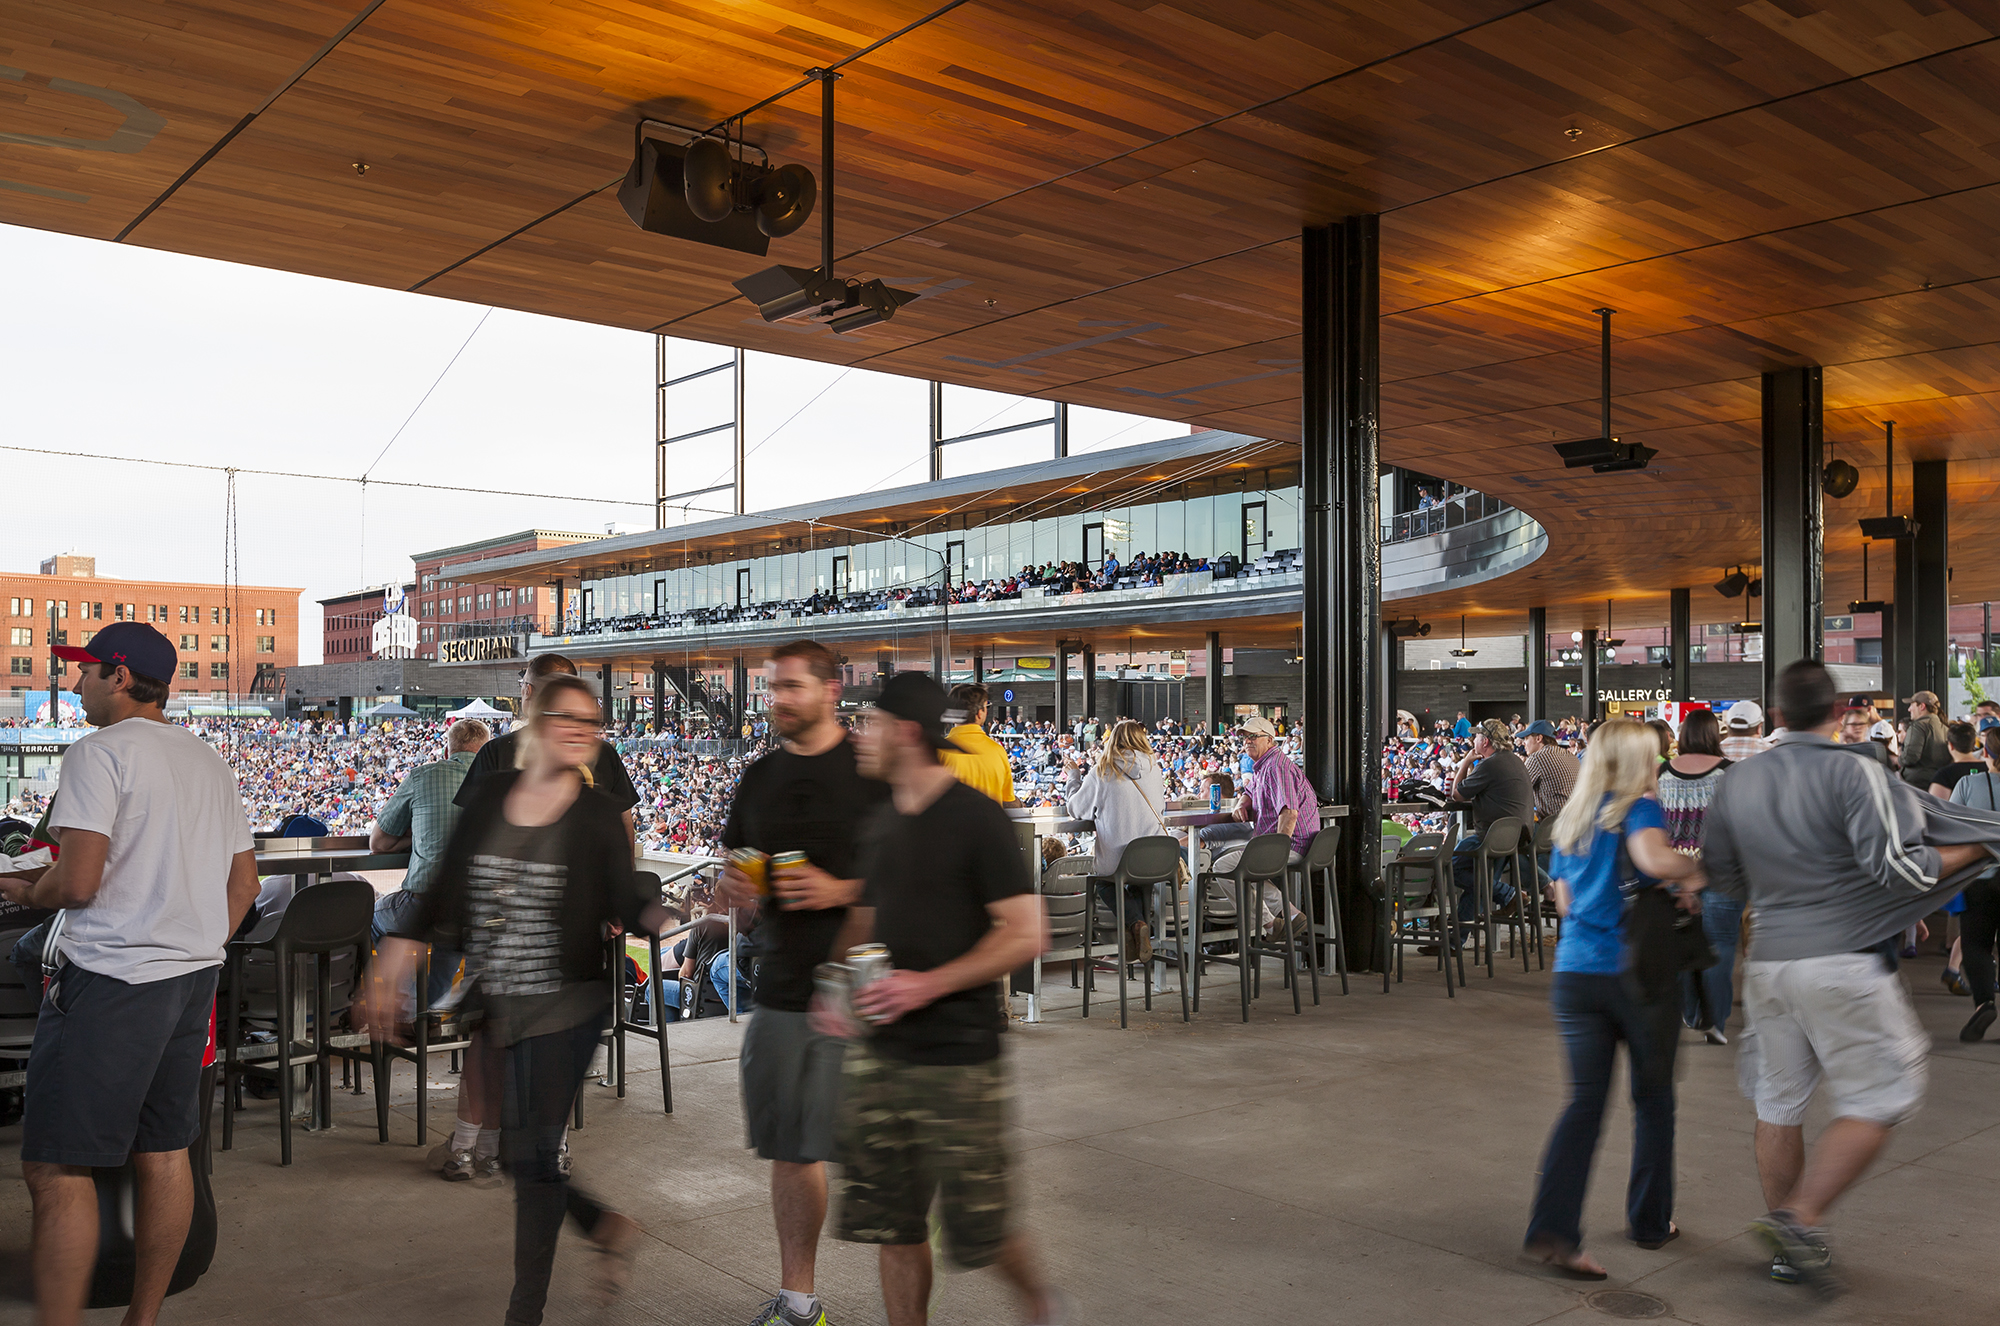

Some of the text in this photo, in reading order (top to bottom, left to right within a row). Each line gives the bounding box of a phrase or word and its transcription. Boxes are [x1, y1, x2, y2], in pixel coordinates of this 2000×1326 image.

[441, 636, 511, 663] SECURIAN
[1598, 689, 1652, 701] GALLERY
[60, 731, 91, 741] TIC
[20, 745, 59, 753] TERRACE
[4, 905, 20, 914] YOU
